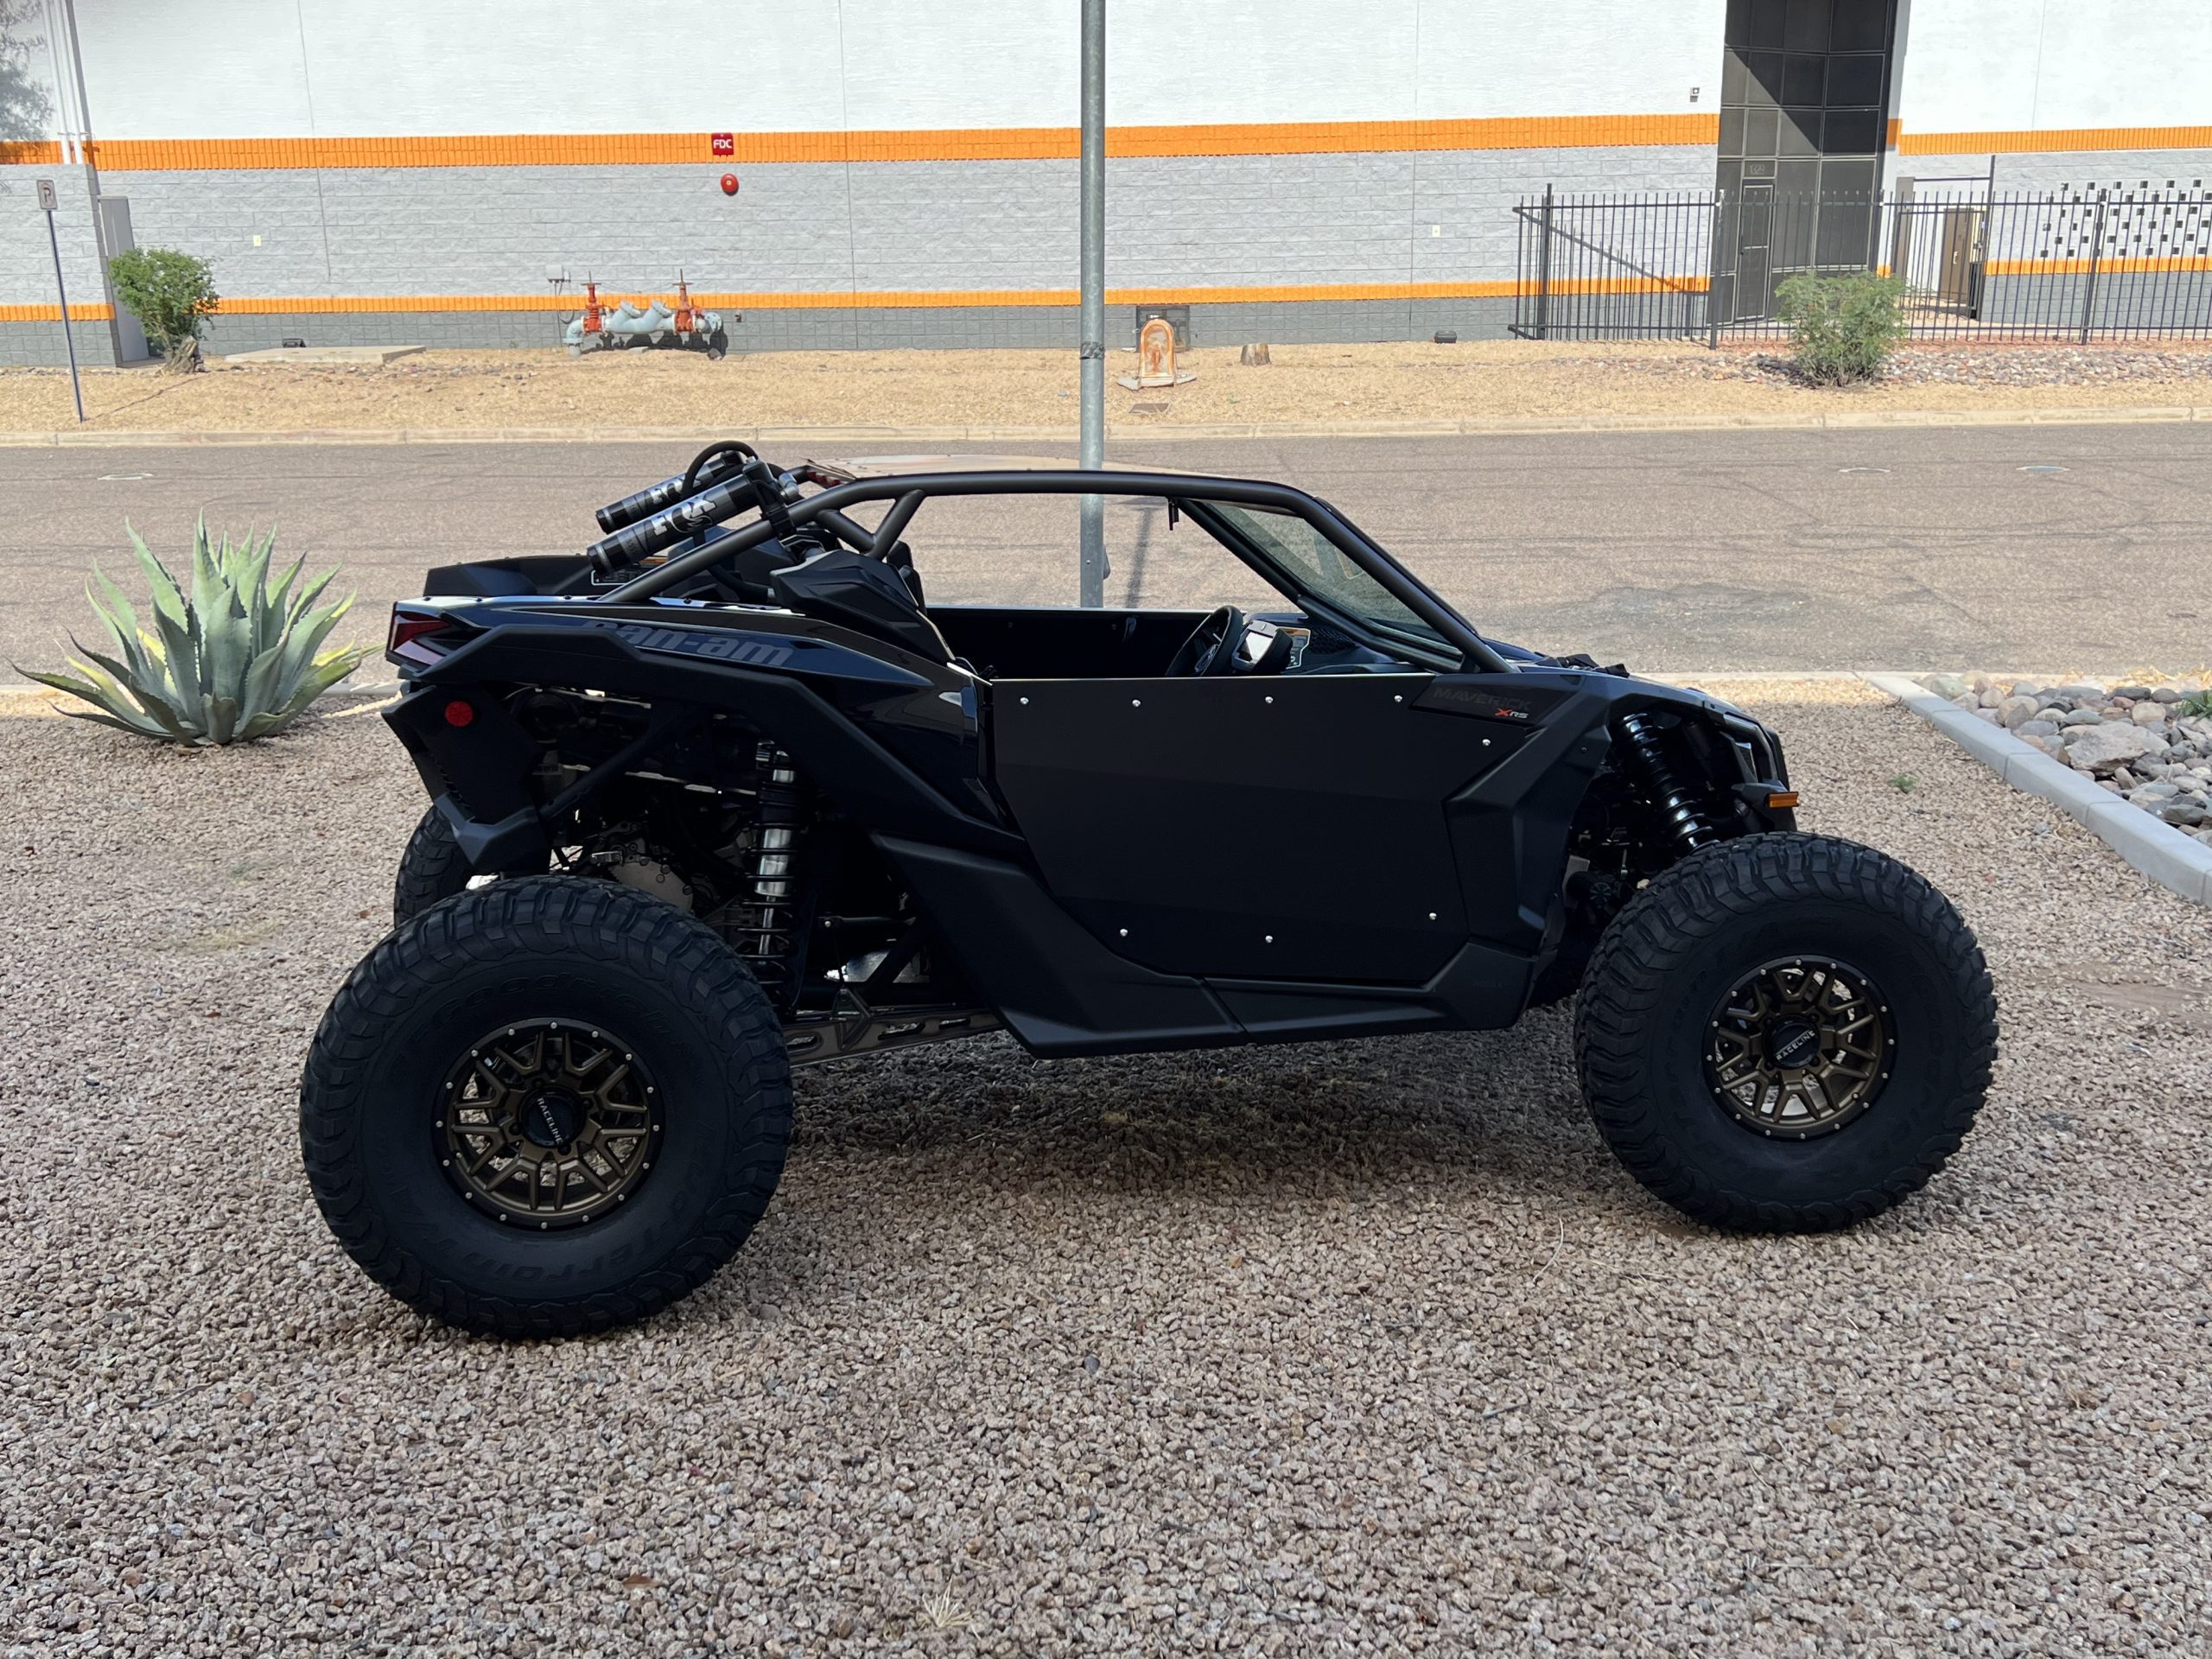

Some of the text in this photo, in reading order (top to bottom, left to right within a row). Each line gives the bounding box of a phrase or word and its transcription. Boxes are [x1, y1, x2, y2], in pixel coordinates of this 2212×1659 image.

[713, 139, 733, 149] FDC
[651, 493, 716, 534] FOX
[1433, 686, 1534, 711] MAVERICK
[1777, 1030, 1815, 1060] RACELINE
[537, 1097, 564, 1145] RACELINE
